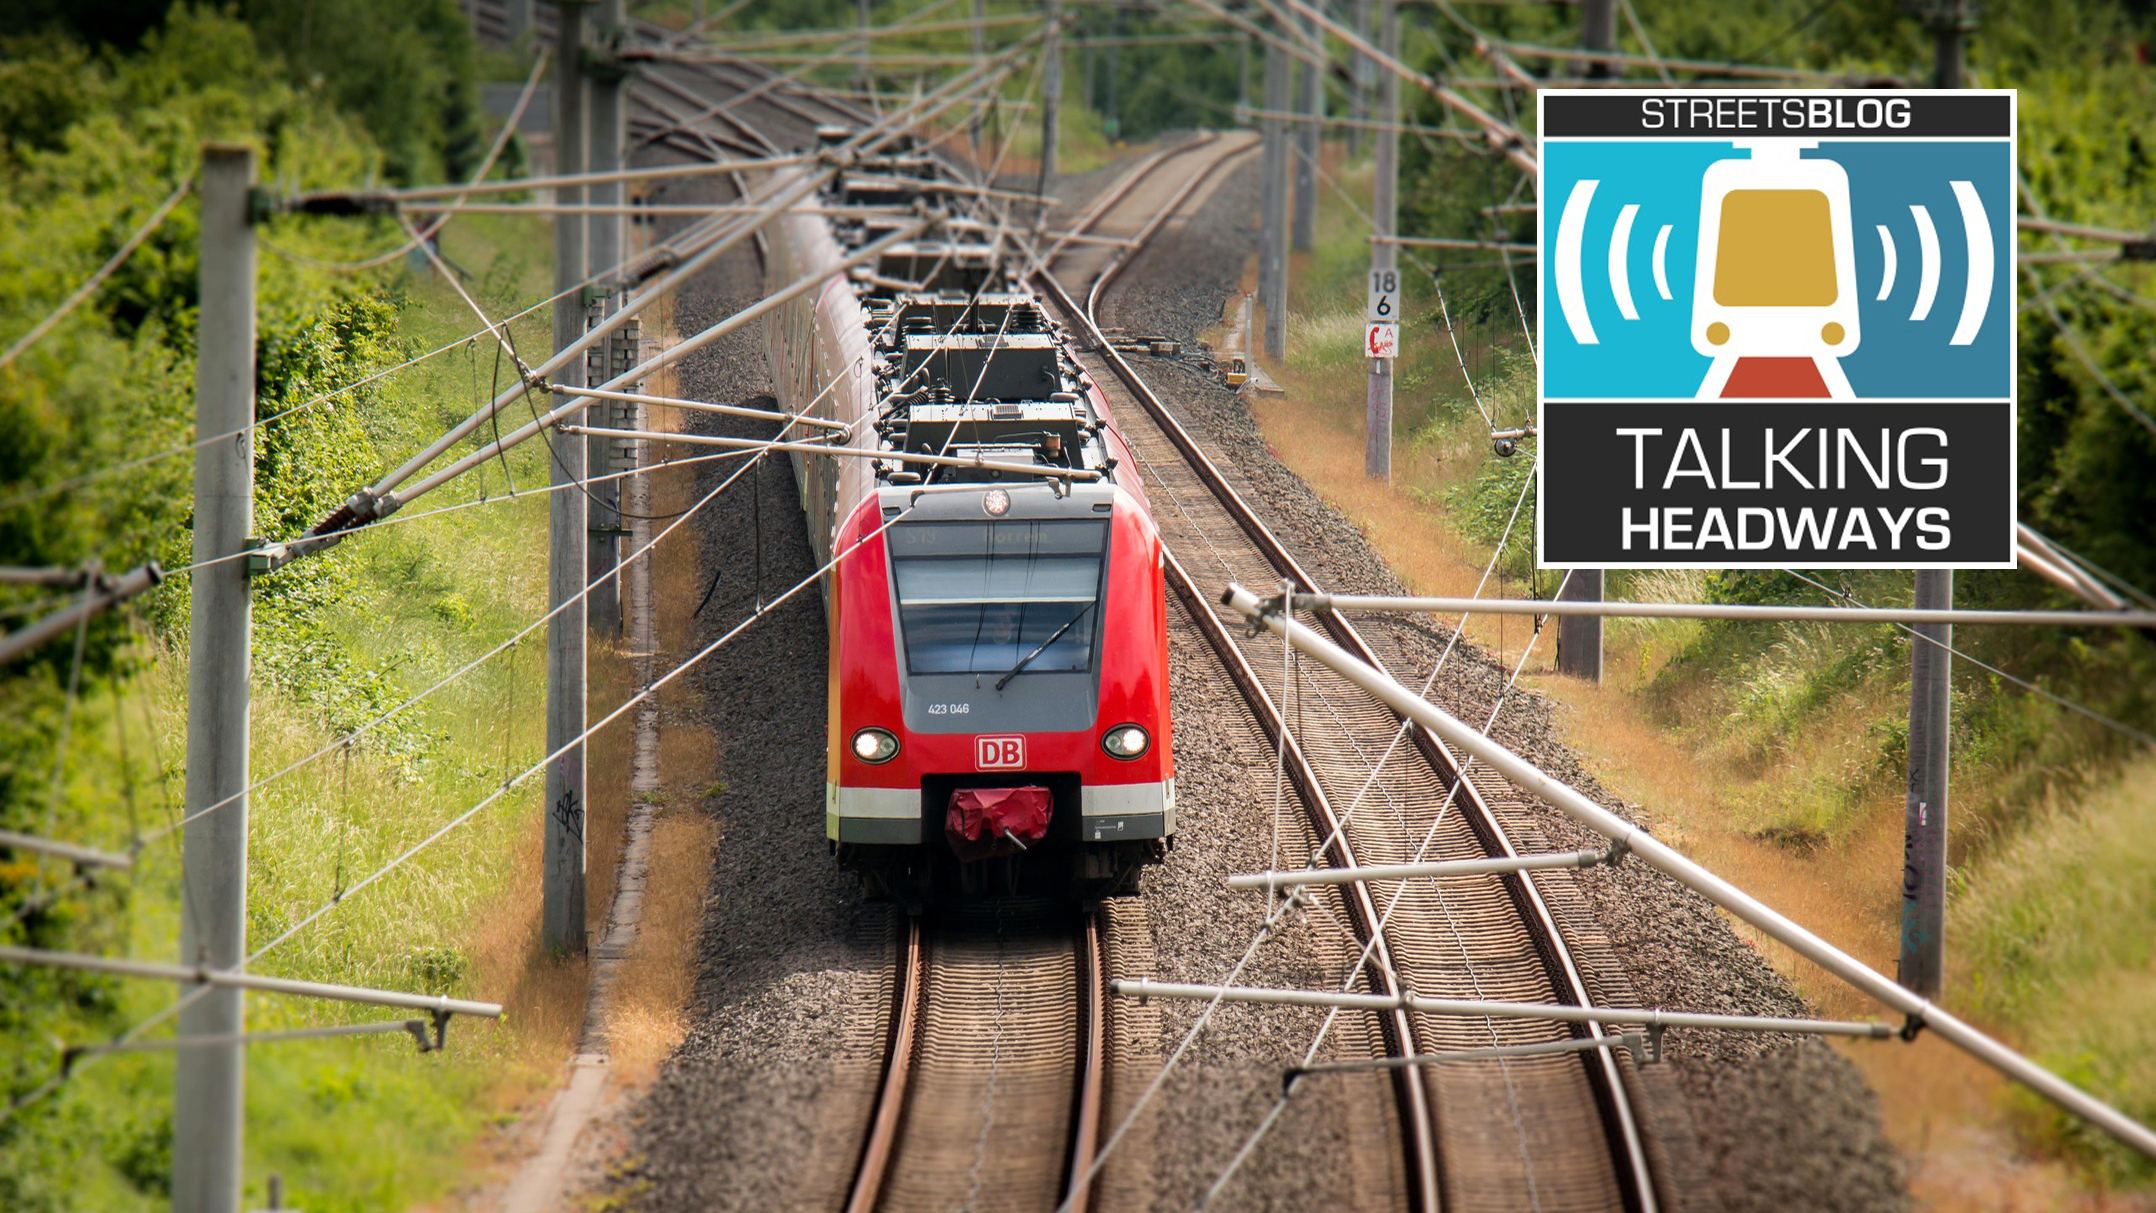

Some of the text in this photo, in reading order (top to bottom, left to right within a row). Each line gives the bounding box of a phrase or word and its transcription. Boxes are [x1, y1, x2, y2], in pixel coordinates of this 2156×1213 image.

[1373, 271, 1396, 292] 18
[1376, 295, 1391, 315] 6
[928, 703, 970, 715] 423 046
[981, 740, 1021, 765] DB
